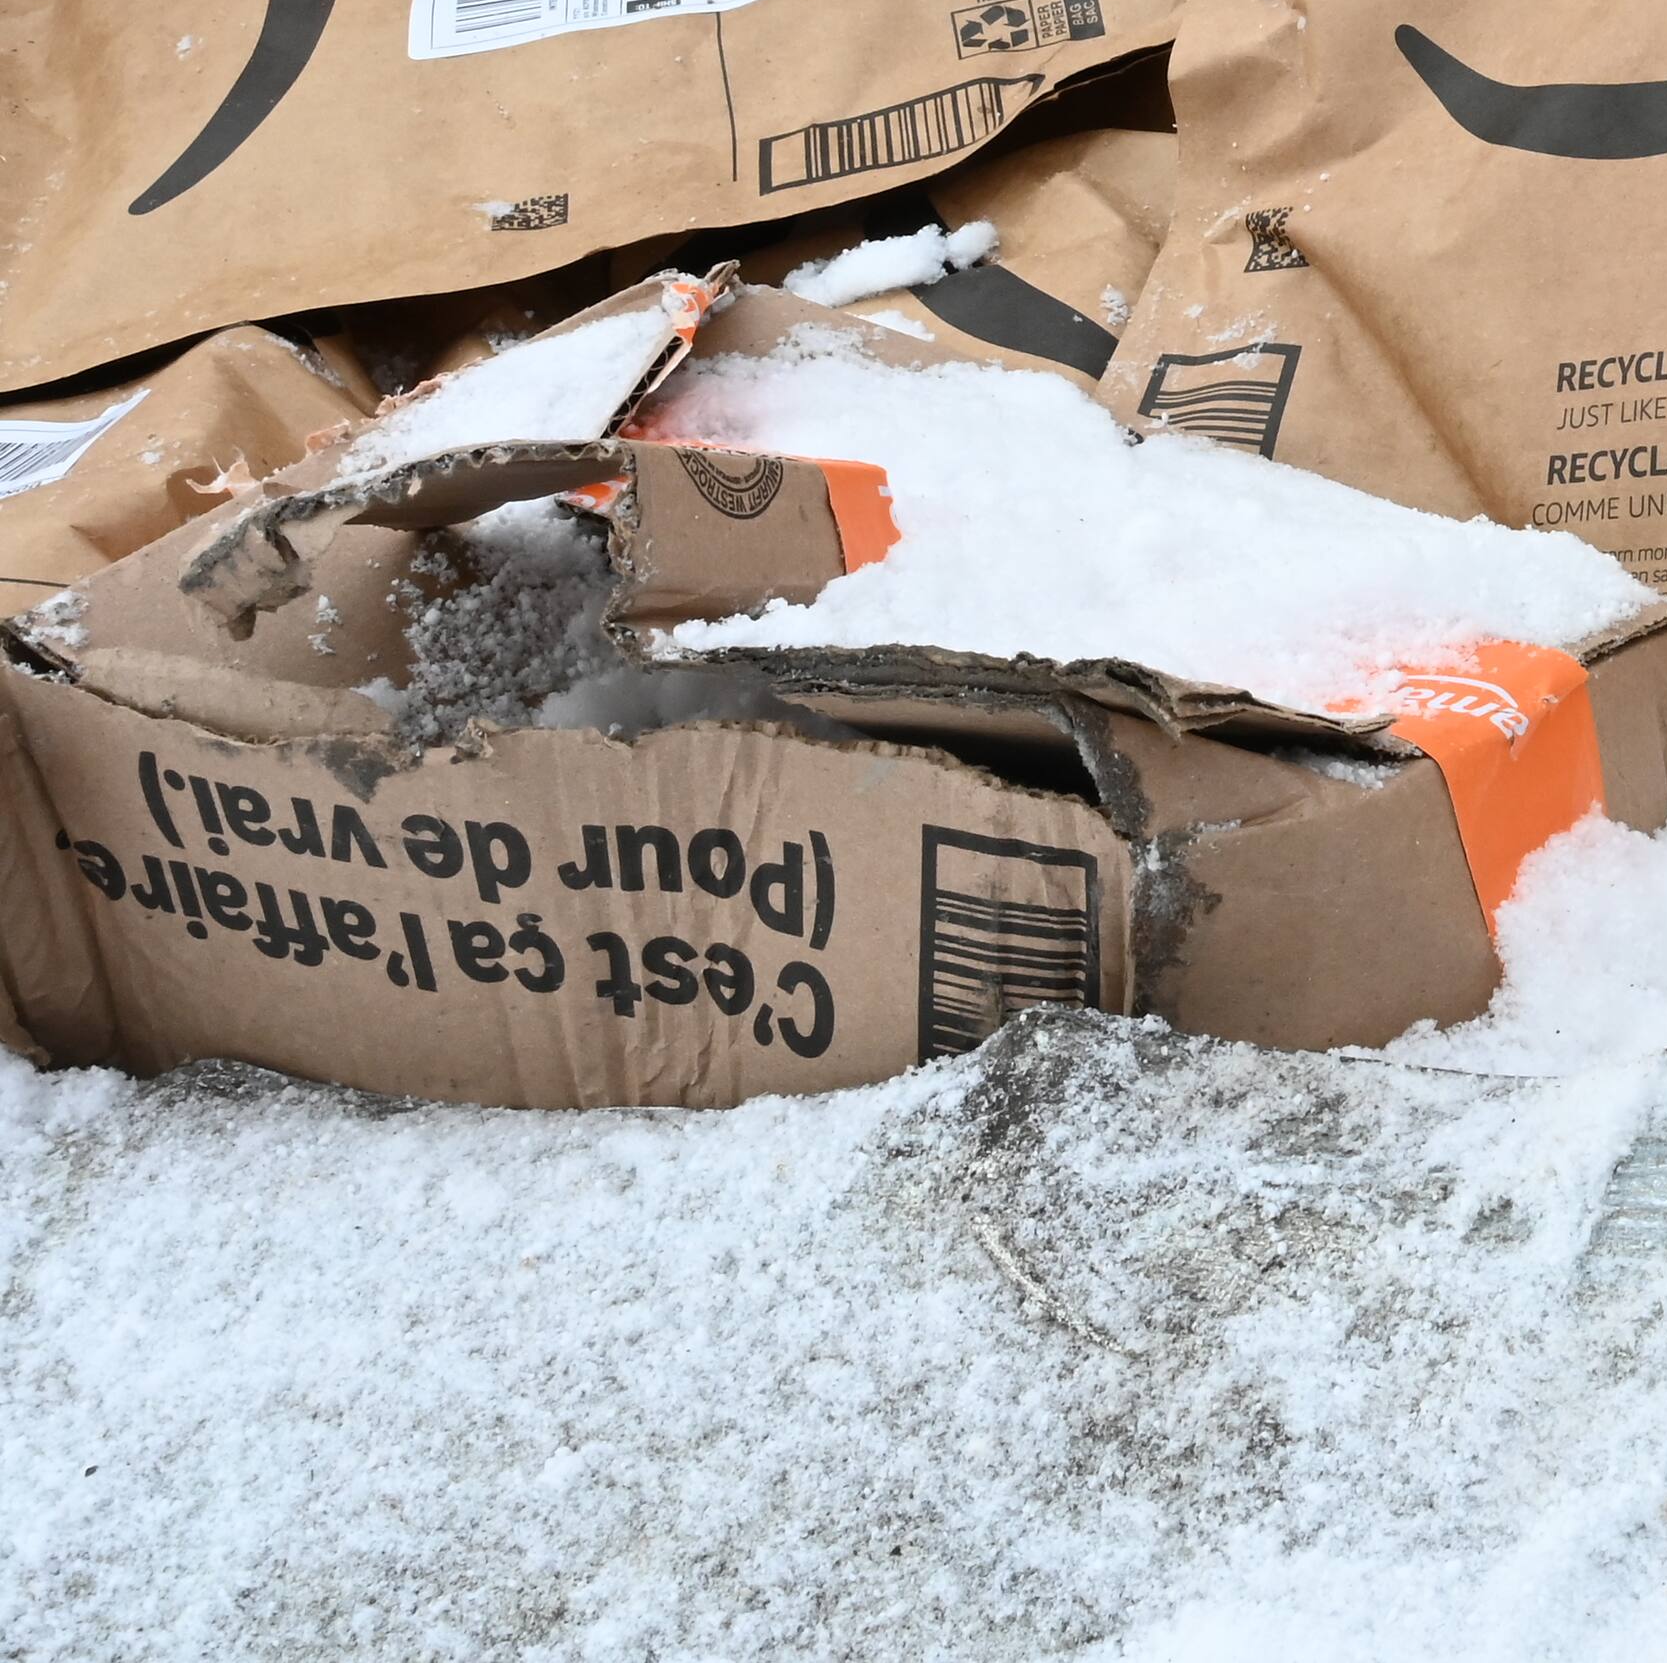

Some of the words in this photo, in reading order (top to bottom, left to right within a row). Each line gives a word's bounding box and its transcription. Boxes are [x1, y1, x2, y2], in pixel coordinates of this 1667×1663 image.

[1041, 4, 1053, 39] PAPER
[1052, 0, 1066, 37] PAPIER
[1072, 2, 1083, 27] BAG
[1556, 402, 1614, 431] JUST
[1620, 396, 1667, 425] LIKE
[681, 450, 748, 513] WESTROCK
[1531, 497, 1620, 527] COMME
[137, 750, 388, 869] vrai.)
[401, 812, 532, 903] de
[448, 912, 566, 994] ça
